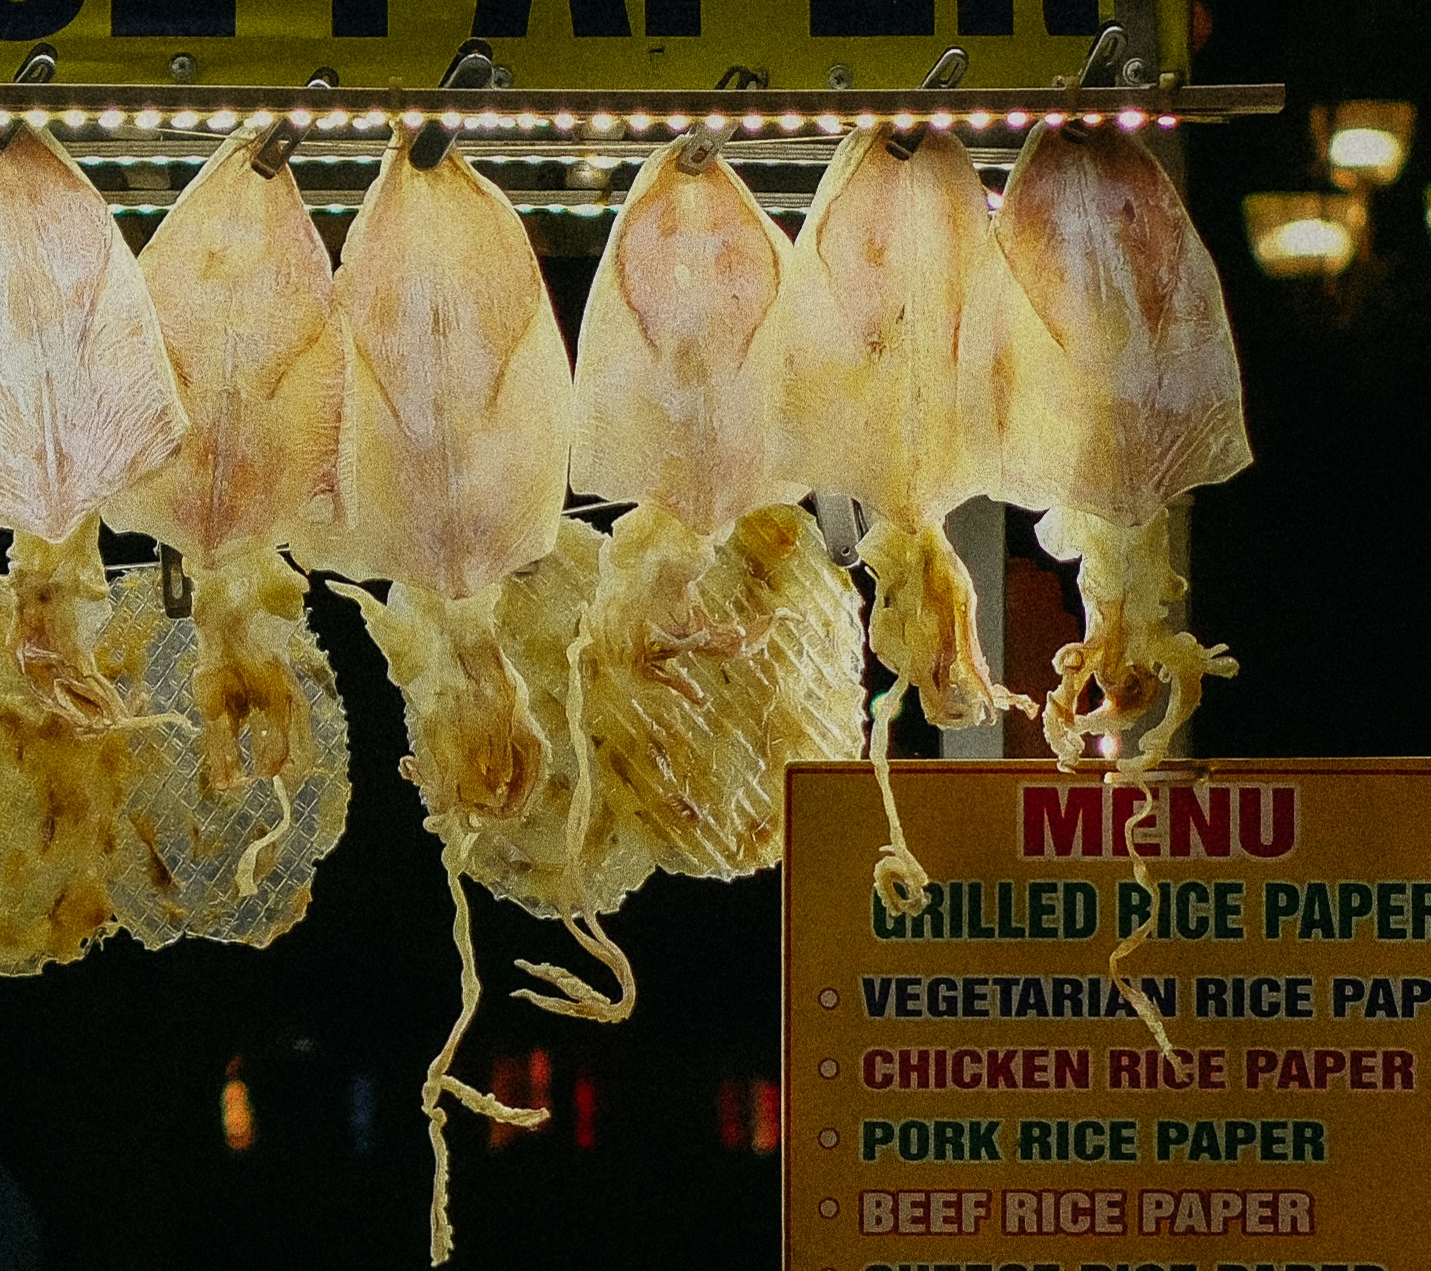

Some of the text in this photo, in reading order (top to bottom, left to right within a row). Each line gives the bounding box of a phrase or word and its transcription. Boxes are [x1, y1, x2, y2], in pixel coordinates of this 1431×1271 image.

[1022, 787, 1296, 857] MENU
[1118, 882, 1245, 939] RICE
[863, 977, 1176, 1018] VEGETARIAN
[1196, 977, 1319, 1018] RICE
[863, 1049, 1414, 1089] CHICKEN RICE PAPER
[863, 1121, 1326, 1161] PORK RICE PAPER
[860, 1191, 1316, 1234] BEEF RICE PAPER
